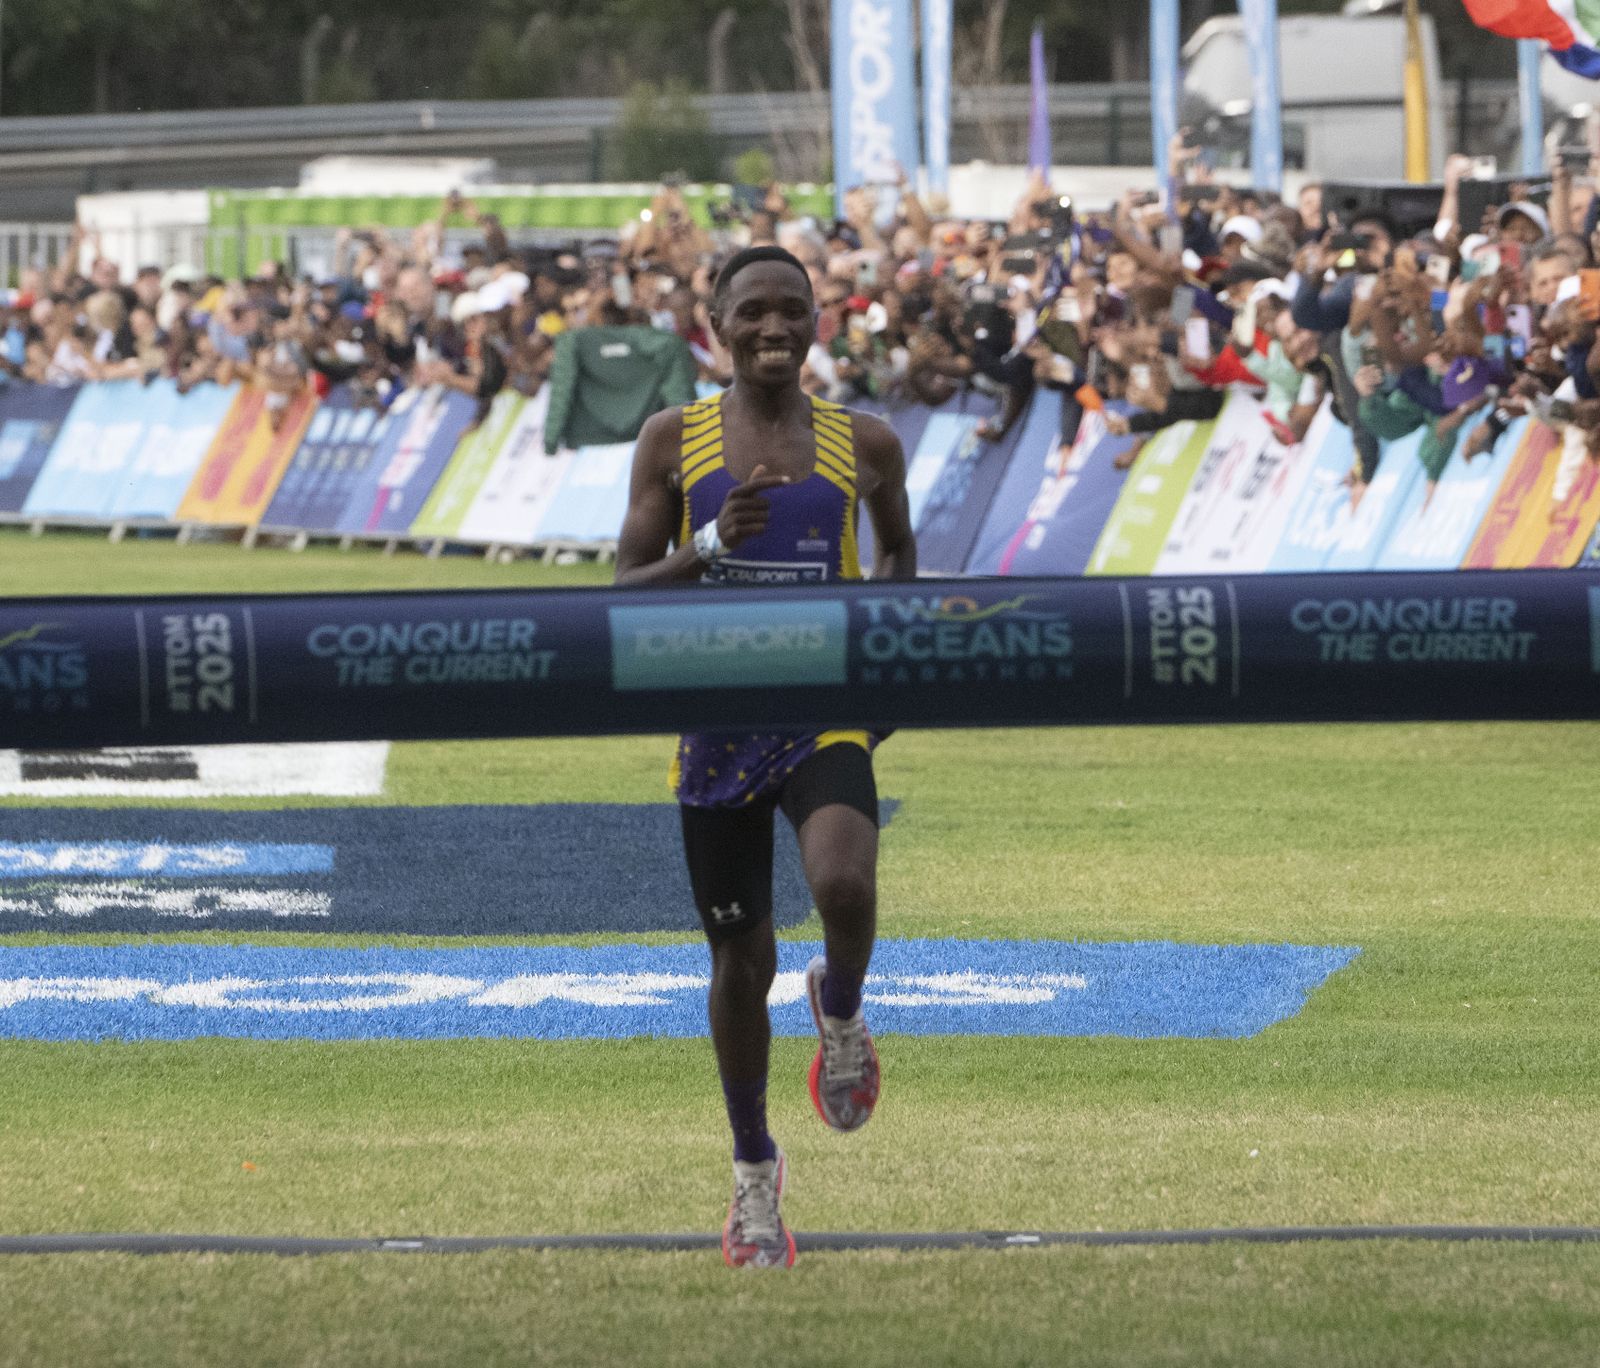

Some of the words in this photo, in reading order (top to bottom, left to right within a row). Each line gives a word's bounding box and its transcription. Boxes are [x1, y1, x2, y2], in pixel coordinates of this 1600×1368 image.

[863, 597, 977, 623] TWO
[1290, 597, 1517, 632] CONQUER
[307, 618, 536, 657] CONQUER
[634, 622, 827, 656] TOTALSPORTS
[861, 621, 1073, 661] OCEANS
[1177, 586, 1218, 684] 2025
[1317, 632, 1379, 663] THE
[1387, 630, 1537, 663] CURRENT
[193, 612, 234, 711] 2025
[335, 656, 398, 687] THE
[405, 650, 556, 685] CURRENT
